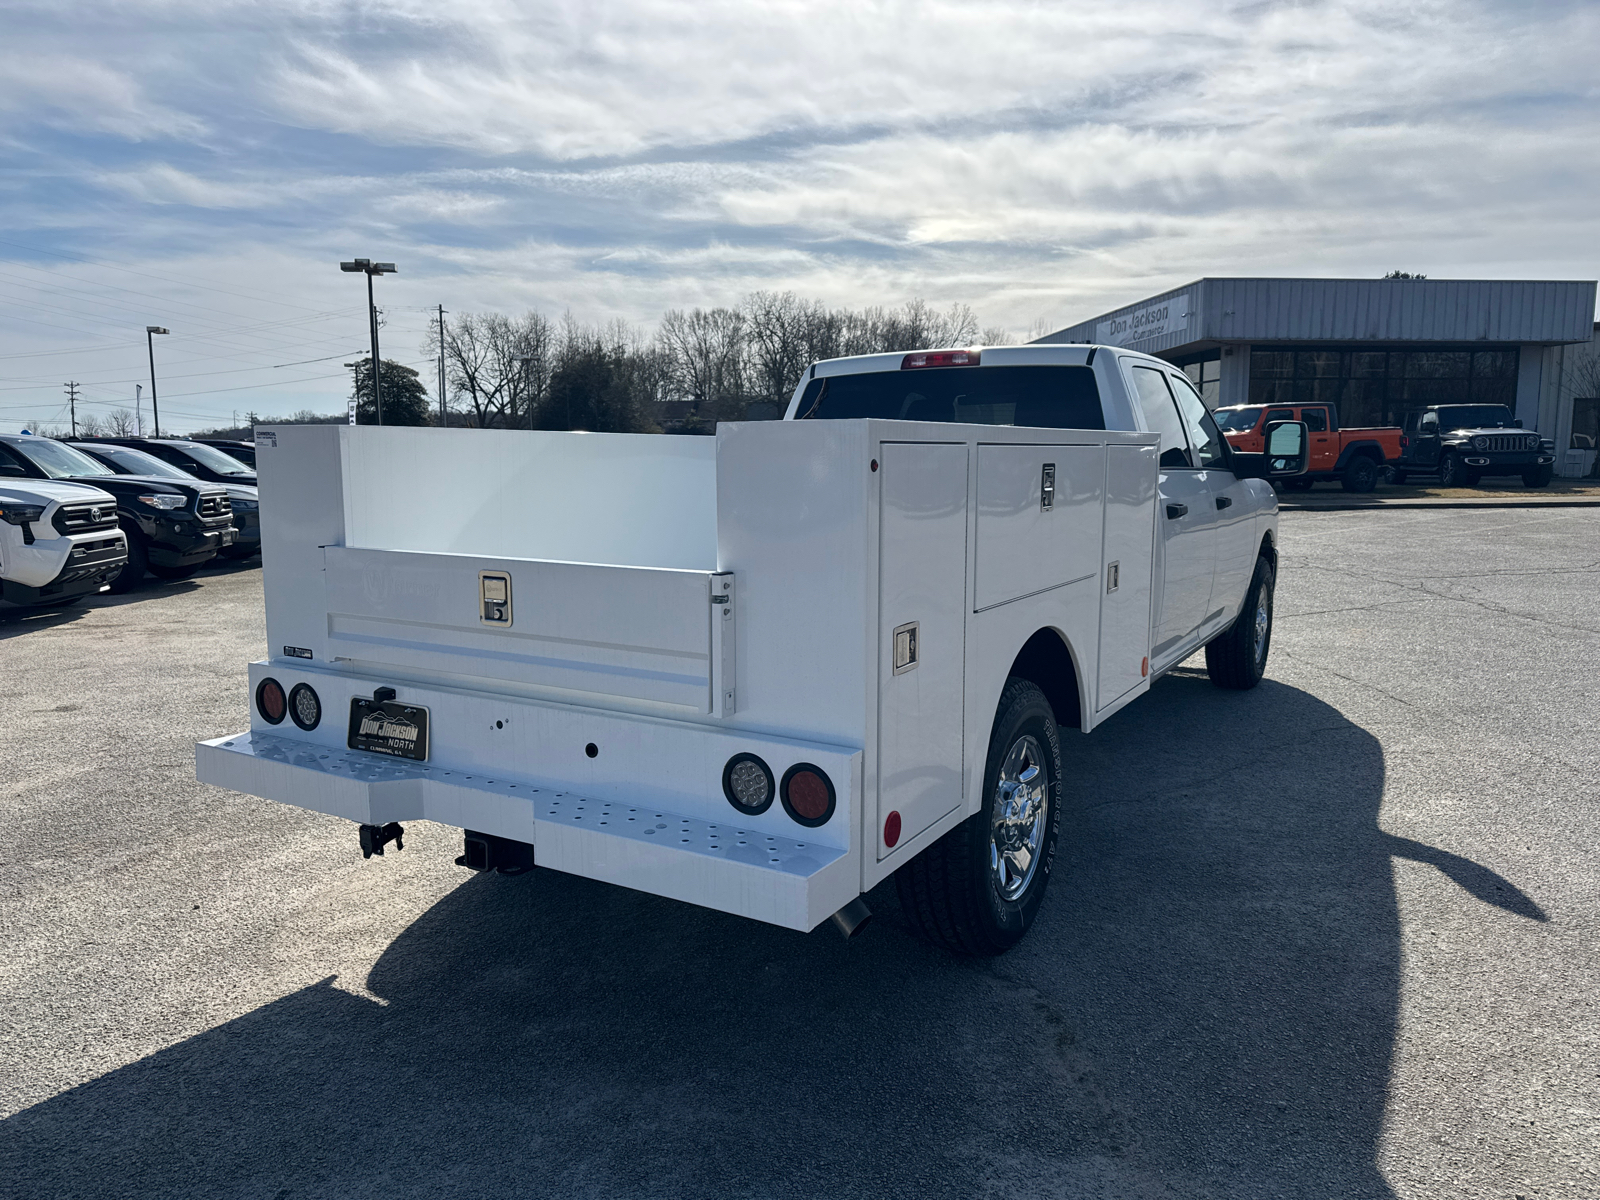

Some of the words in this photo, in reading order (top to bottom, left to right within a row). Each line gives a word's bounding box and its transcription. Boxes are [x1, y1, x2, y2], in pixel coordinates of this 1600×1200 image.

[1110, 320, 1126, 335] Don
[1129, 306, 1168, 329] Jackson
[1133, 325, 1164, 340] Commerce
[359, 718, 379, 735] DON
[378, 722, 418, 741] JACKSON
[388, 738, 415, 750] NORTH
